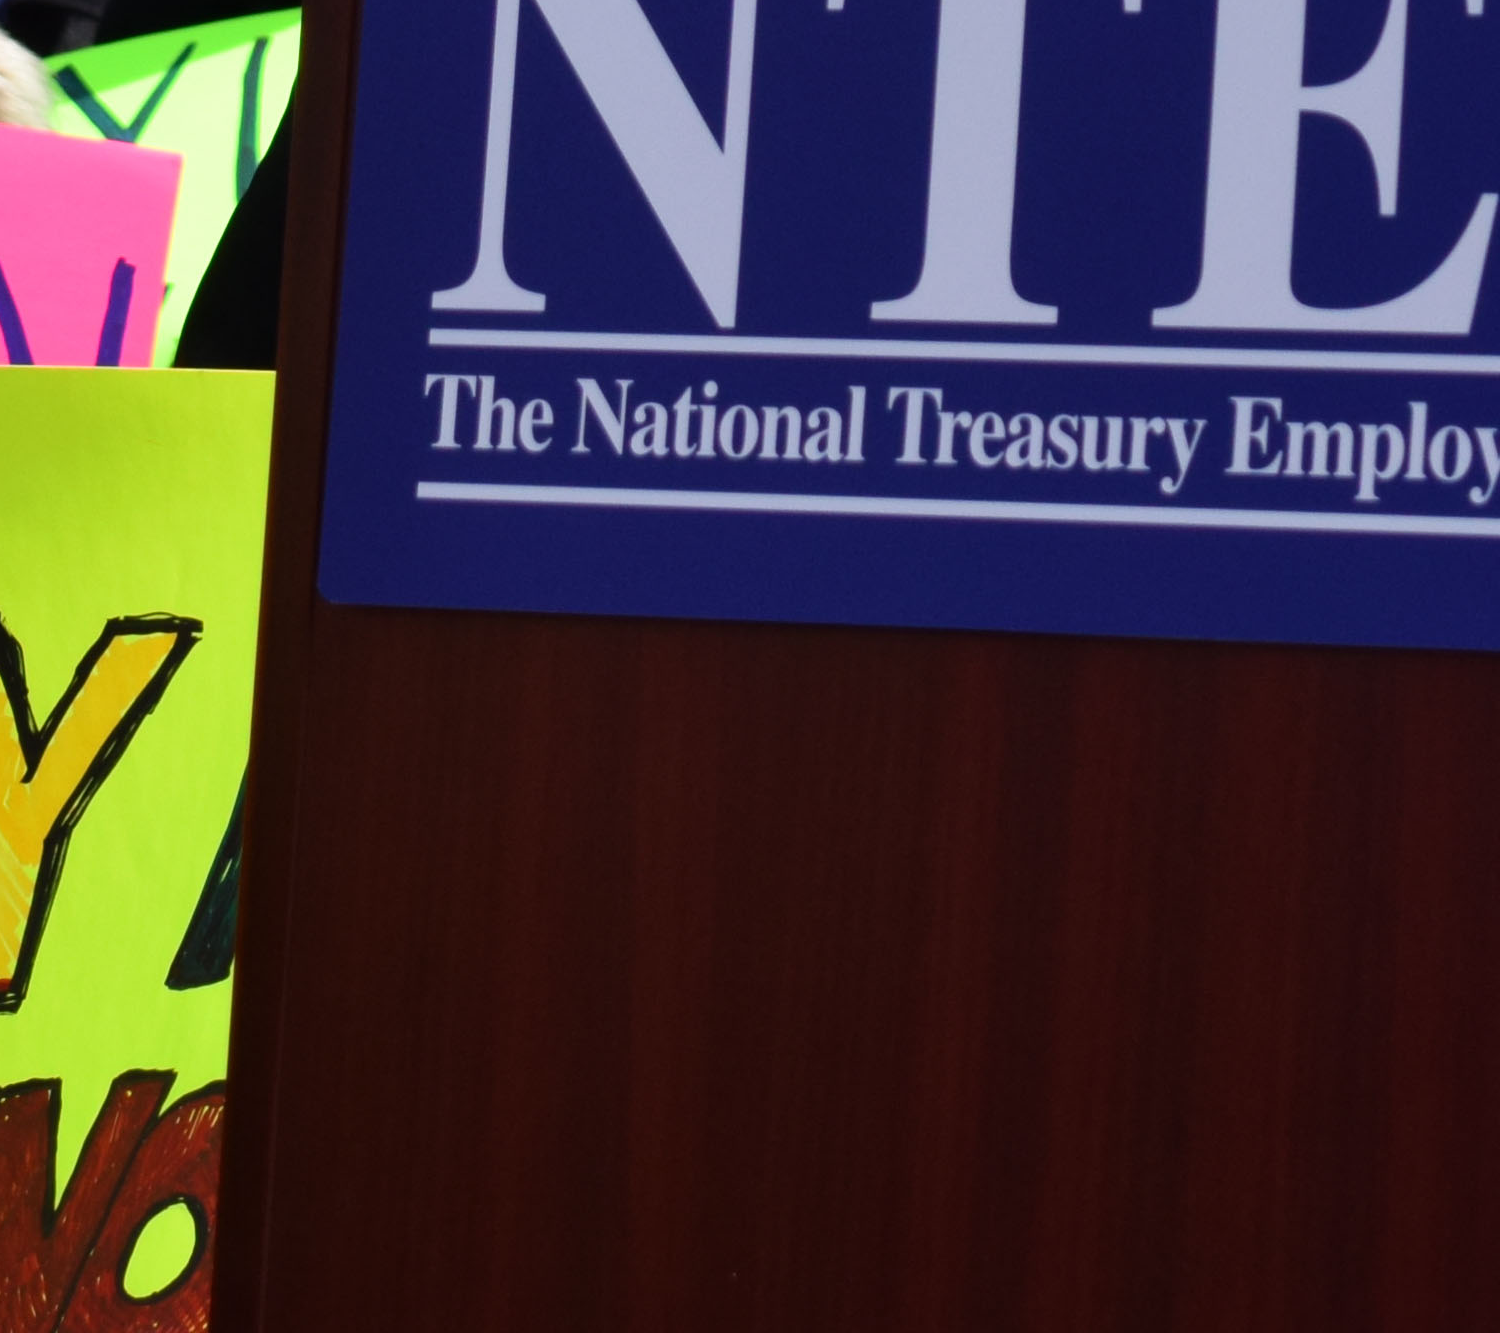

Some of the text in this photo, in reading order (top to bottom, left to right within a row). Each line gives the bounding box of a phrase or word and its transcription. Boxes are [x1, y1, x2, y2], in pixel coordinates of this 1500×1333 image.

[424, 373, 554, 452] The
[571, 378, 867, 462] National
[888, 386, 1207, 494] Treasury
